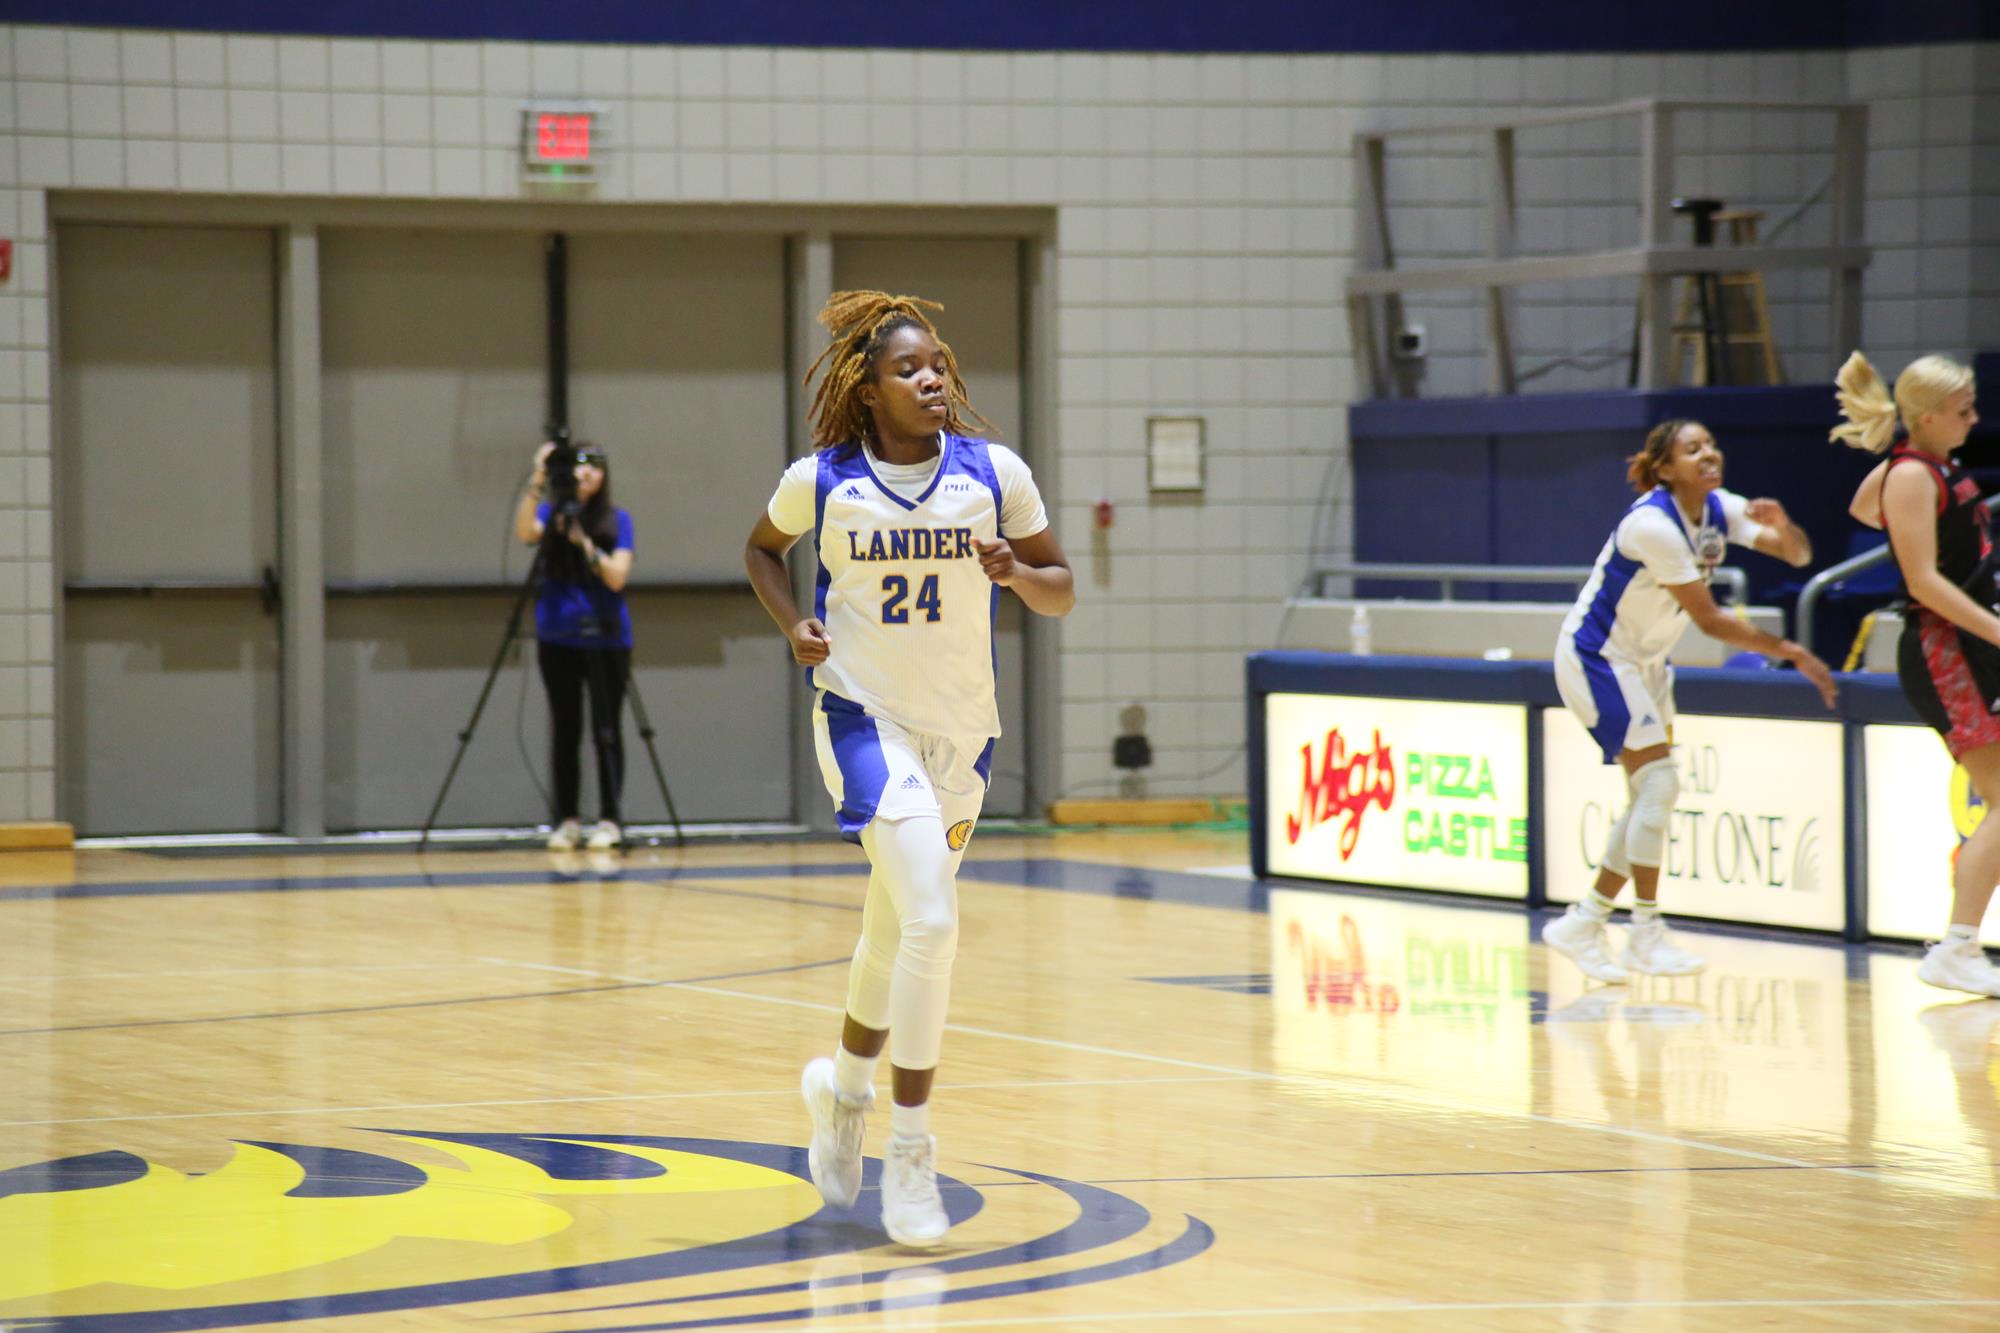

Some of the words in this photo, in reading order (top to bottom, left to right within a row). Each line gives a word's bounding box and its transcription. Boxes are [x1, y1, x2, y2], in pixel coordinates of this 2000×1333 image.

[847, 527, 974, 561] LANDER
[880, 573, 942, 624] 24
[1406, 752, 1497, 801] PIZZA
[1405, 810, 1528, 862] CASTLE
[1714, 810, 1785, 887] ONE
